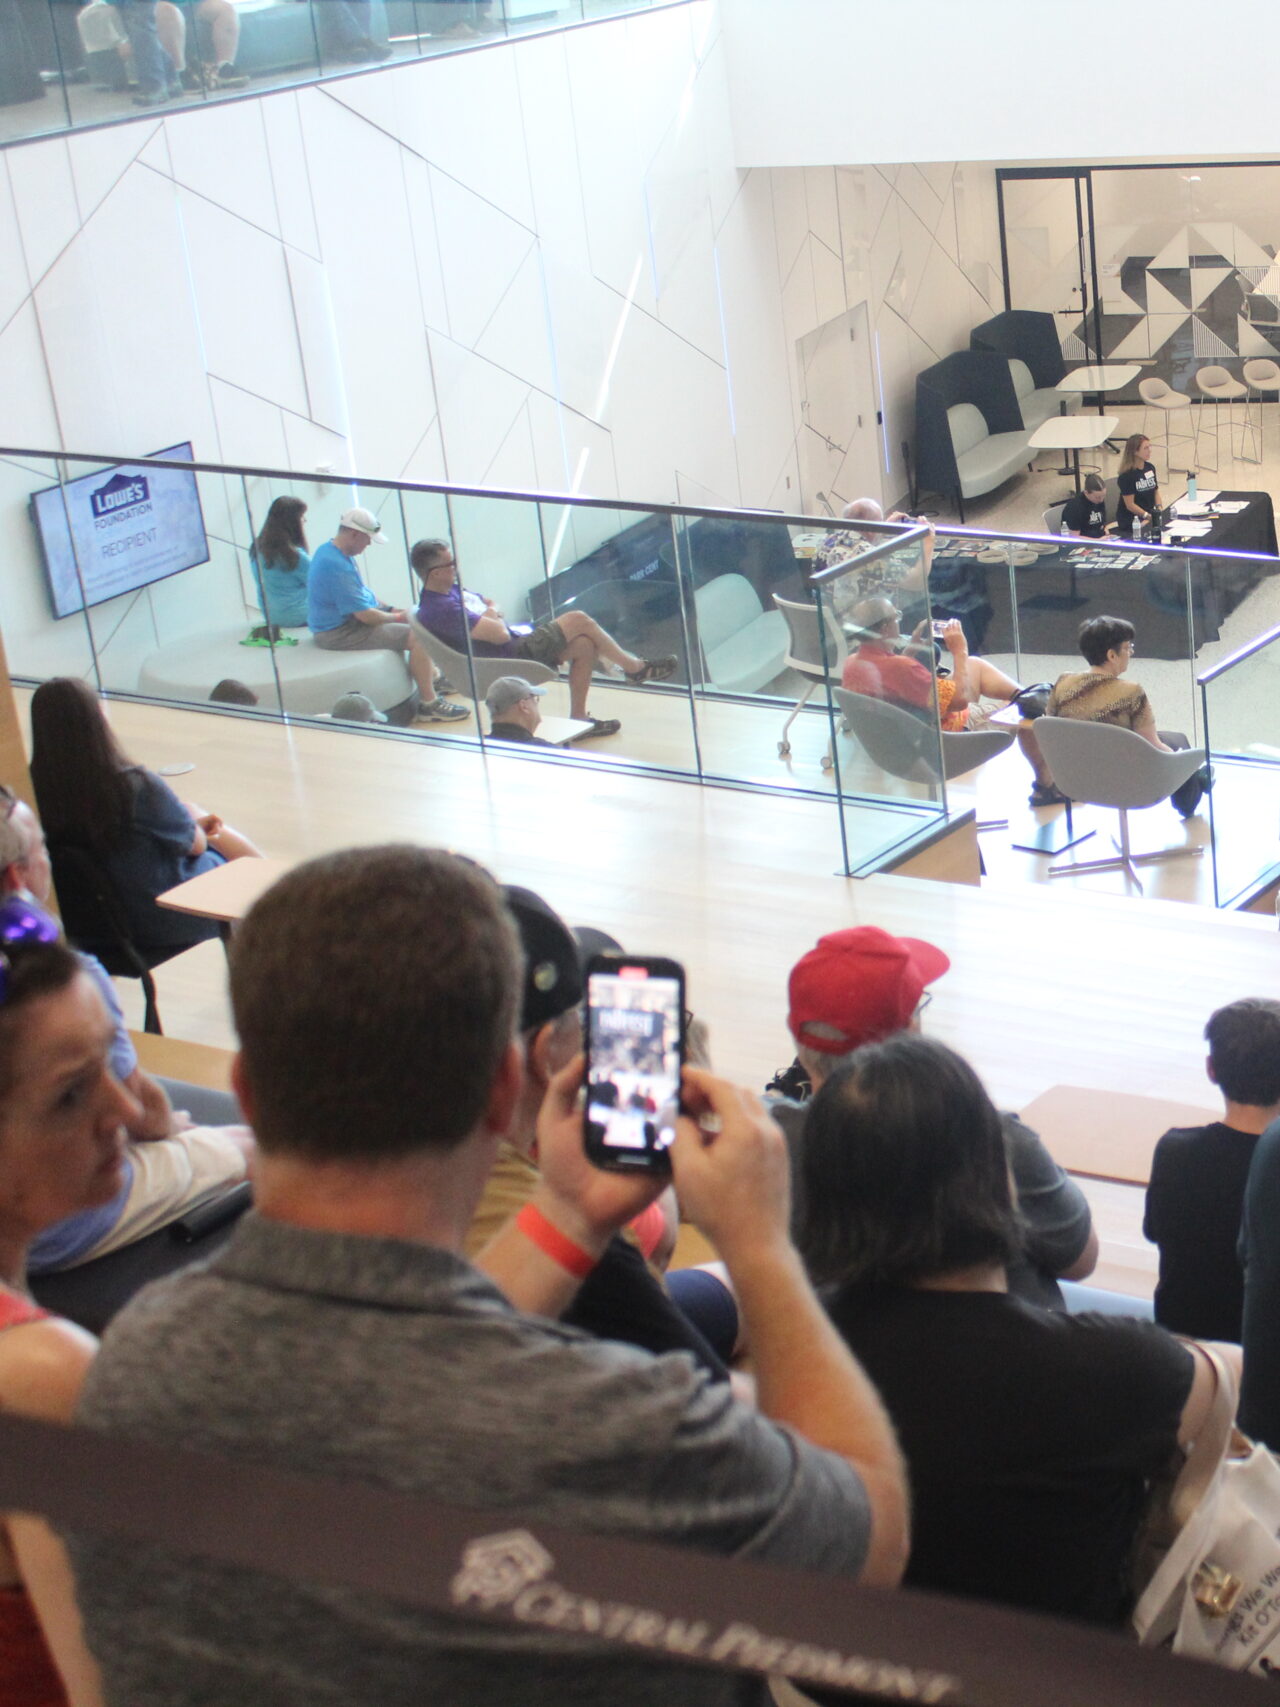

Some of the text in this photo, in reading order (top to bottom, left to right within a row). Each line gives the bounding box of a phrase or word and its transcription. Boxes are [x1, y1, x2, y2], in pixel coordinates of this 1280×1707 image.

[95, 482, 144, 513] LOWE'S
[94, 502, 153, 531] FOUNDATION
[101, 528, 157, 559] RECIPIENT
